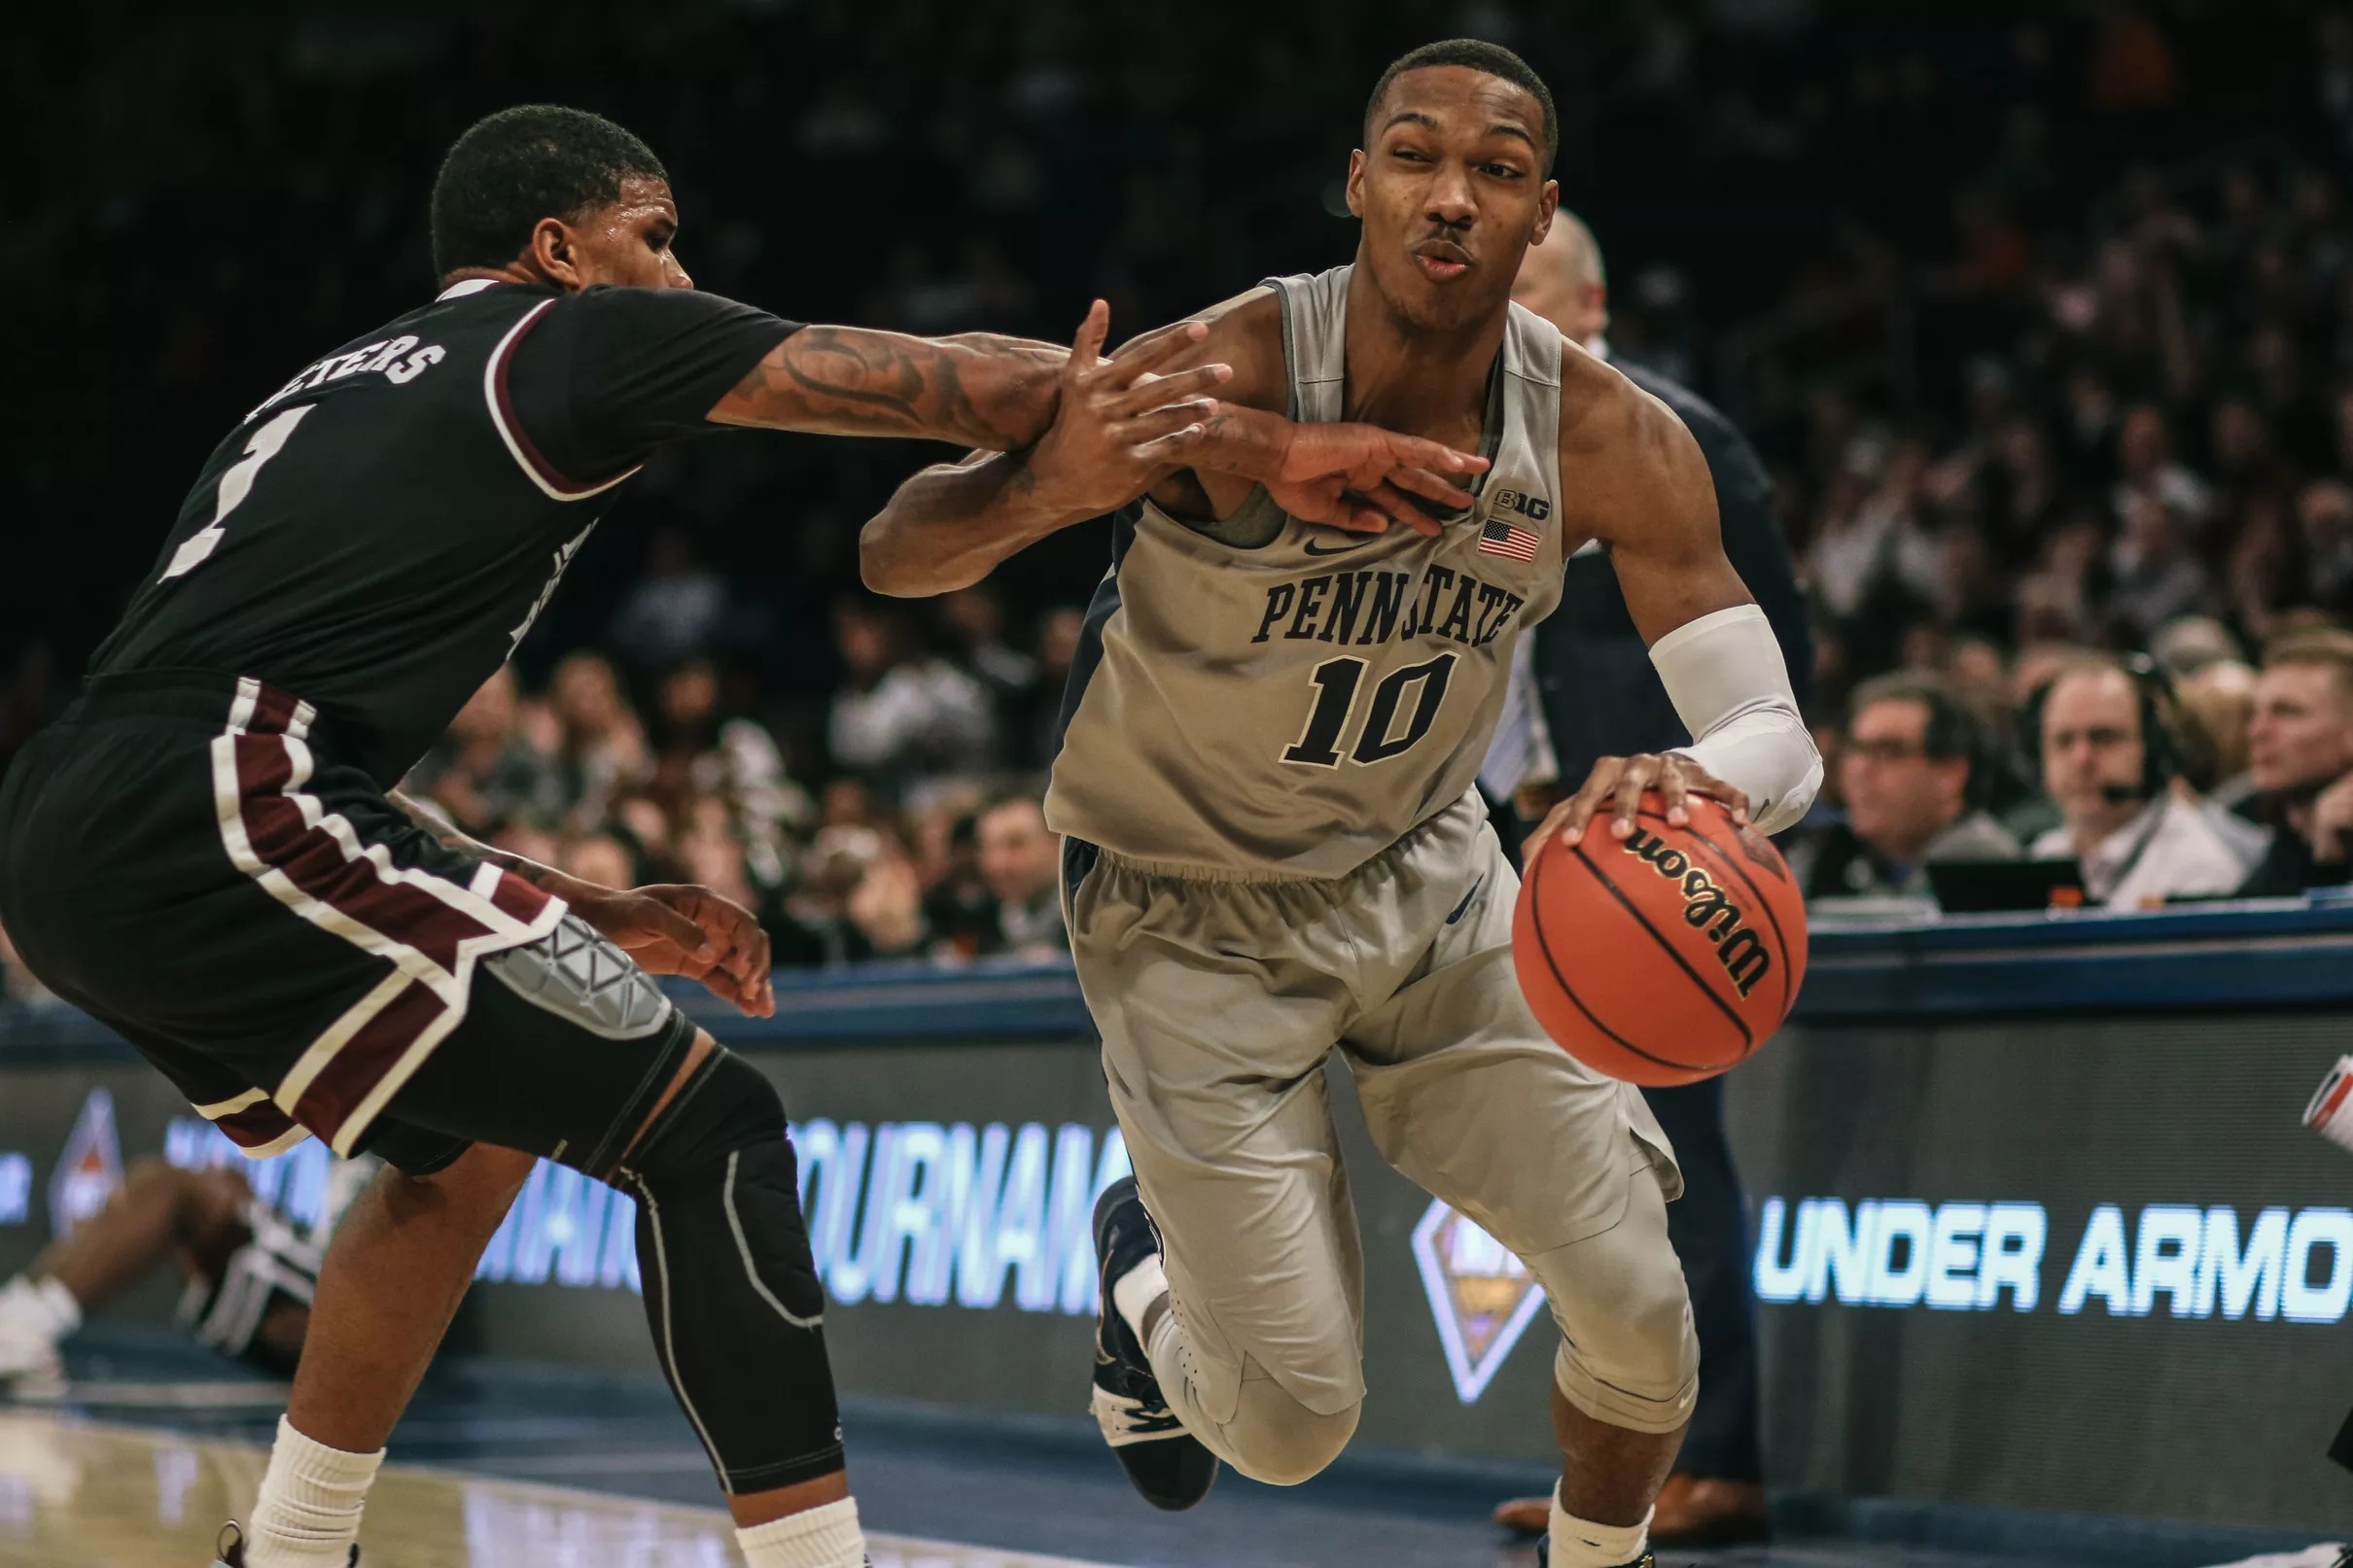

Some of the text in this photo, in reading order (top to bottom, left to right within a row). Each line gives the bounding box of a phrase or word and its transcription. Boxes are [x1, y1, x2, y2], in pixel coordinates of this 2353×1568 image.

[1249, 570, 1410, 645] PENN
[1278, 649, 1461, 770] 10
[1622, 826, 1771, 1001] Wilson
[786, 1118, 1134, 1316] OURNAM
[1753, 1197, 2048, 1312] UNDER
